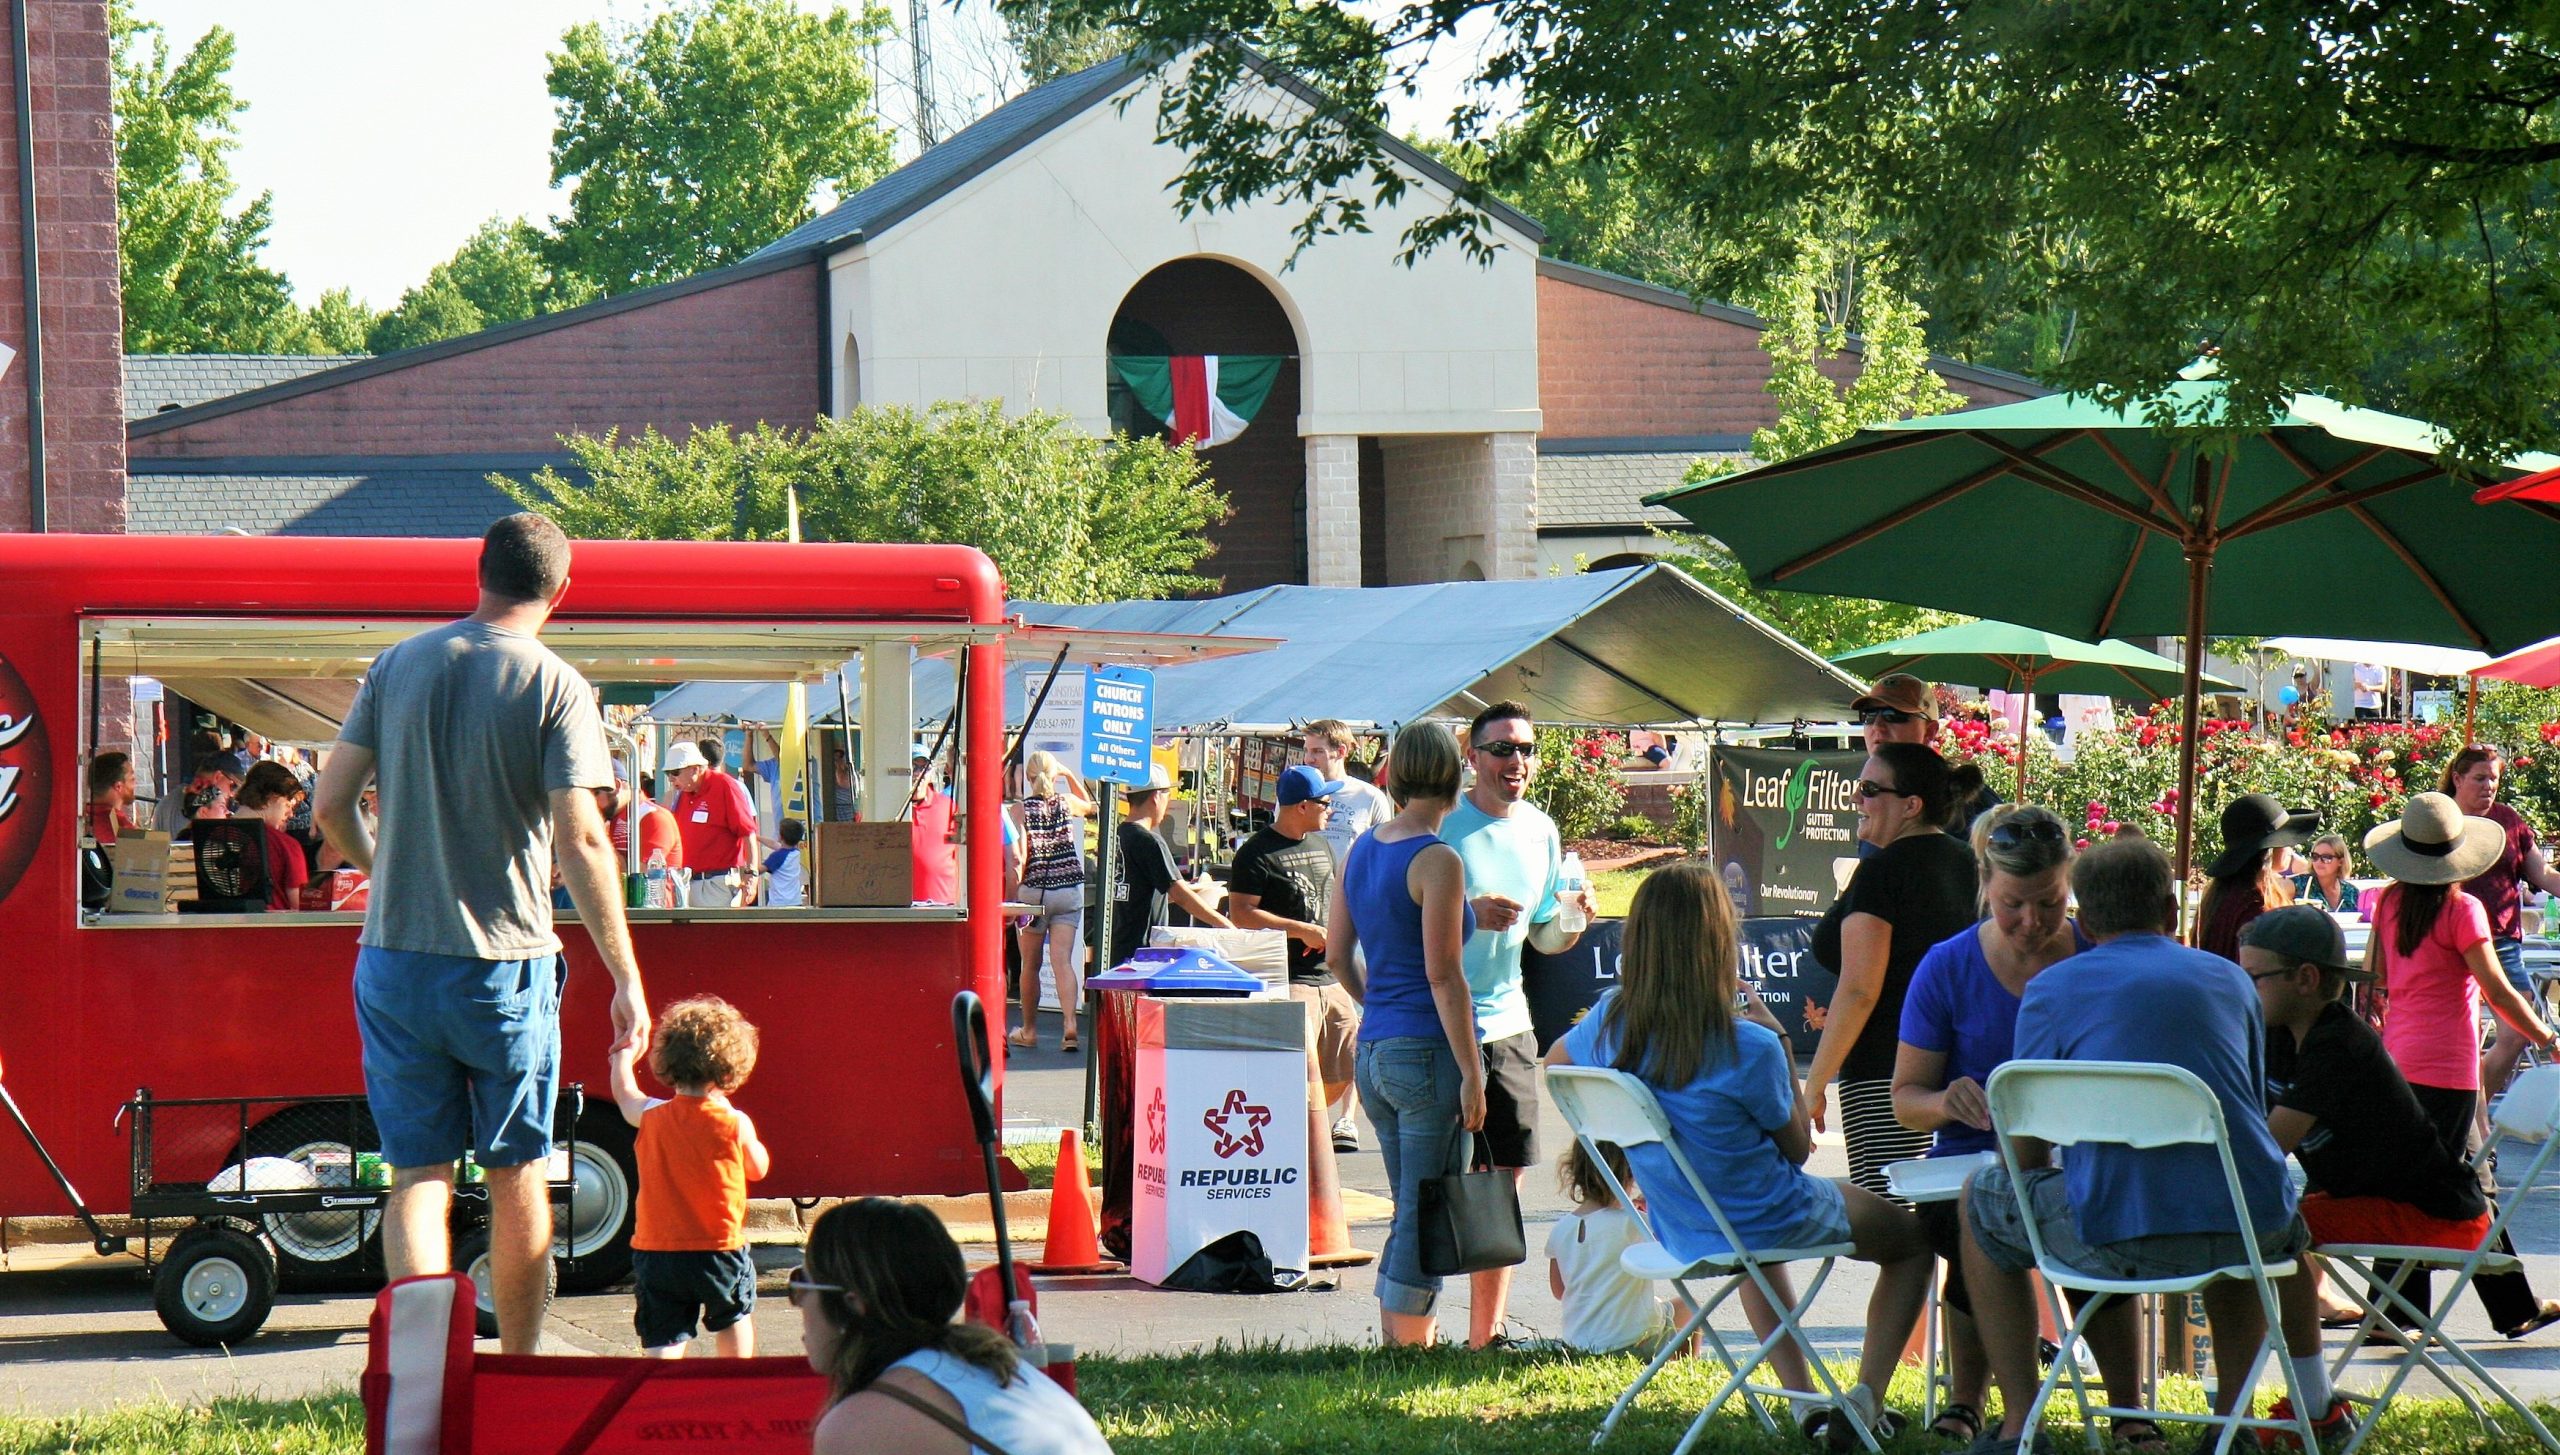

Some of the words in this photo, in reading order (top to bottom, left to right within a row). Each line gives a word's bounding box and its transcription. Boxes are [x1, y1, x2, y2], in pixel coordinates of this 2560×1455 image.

[1096, 684, 1142, 703] CHURCH
[1092, 700, 1145, 720] PATRONS
[1102, 719, 1134, 736] ONLY
[1097, 742, 1109, 752] All
[1110, 743, 1136, 756] Others
[1090, 753, 1105, 764] Will
[1106, 755, 1117, 766] Be
[1118, 757, 1143, 770] Towed
[1743, 768, 1792, 808] Leaf
[1806, 769, 1861, 812] Filter
[1806, 813, 1834, 827] GUTTER
[1805, 827, 1850, 842] PROTECTION
[1760, 883, 1773, 897] Our
[1772, 883, 1819, 905] Revolutionary
[1736, 943, 1803, 978] lter
[1137, 1162, 1166, 1185] REPUBL
[1180, 1168, 1298, 1187] REPUBLIC
[1206, 1187, 1271, 1200] SERVICES
